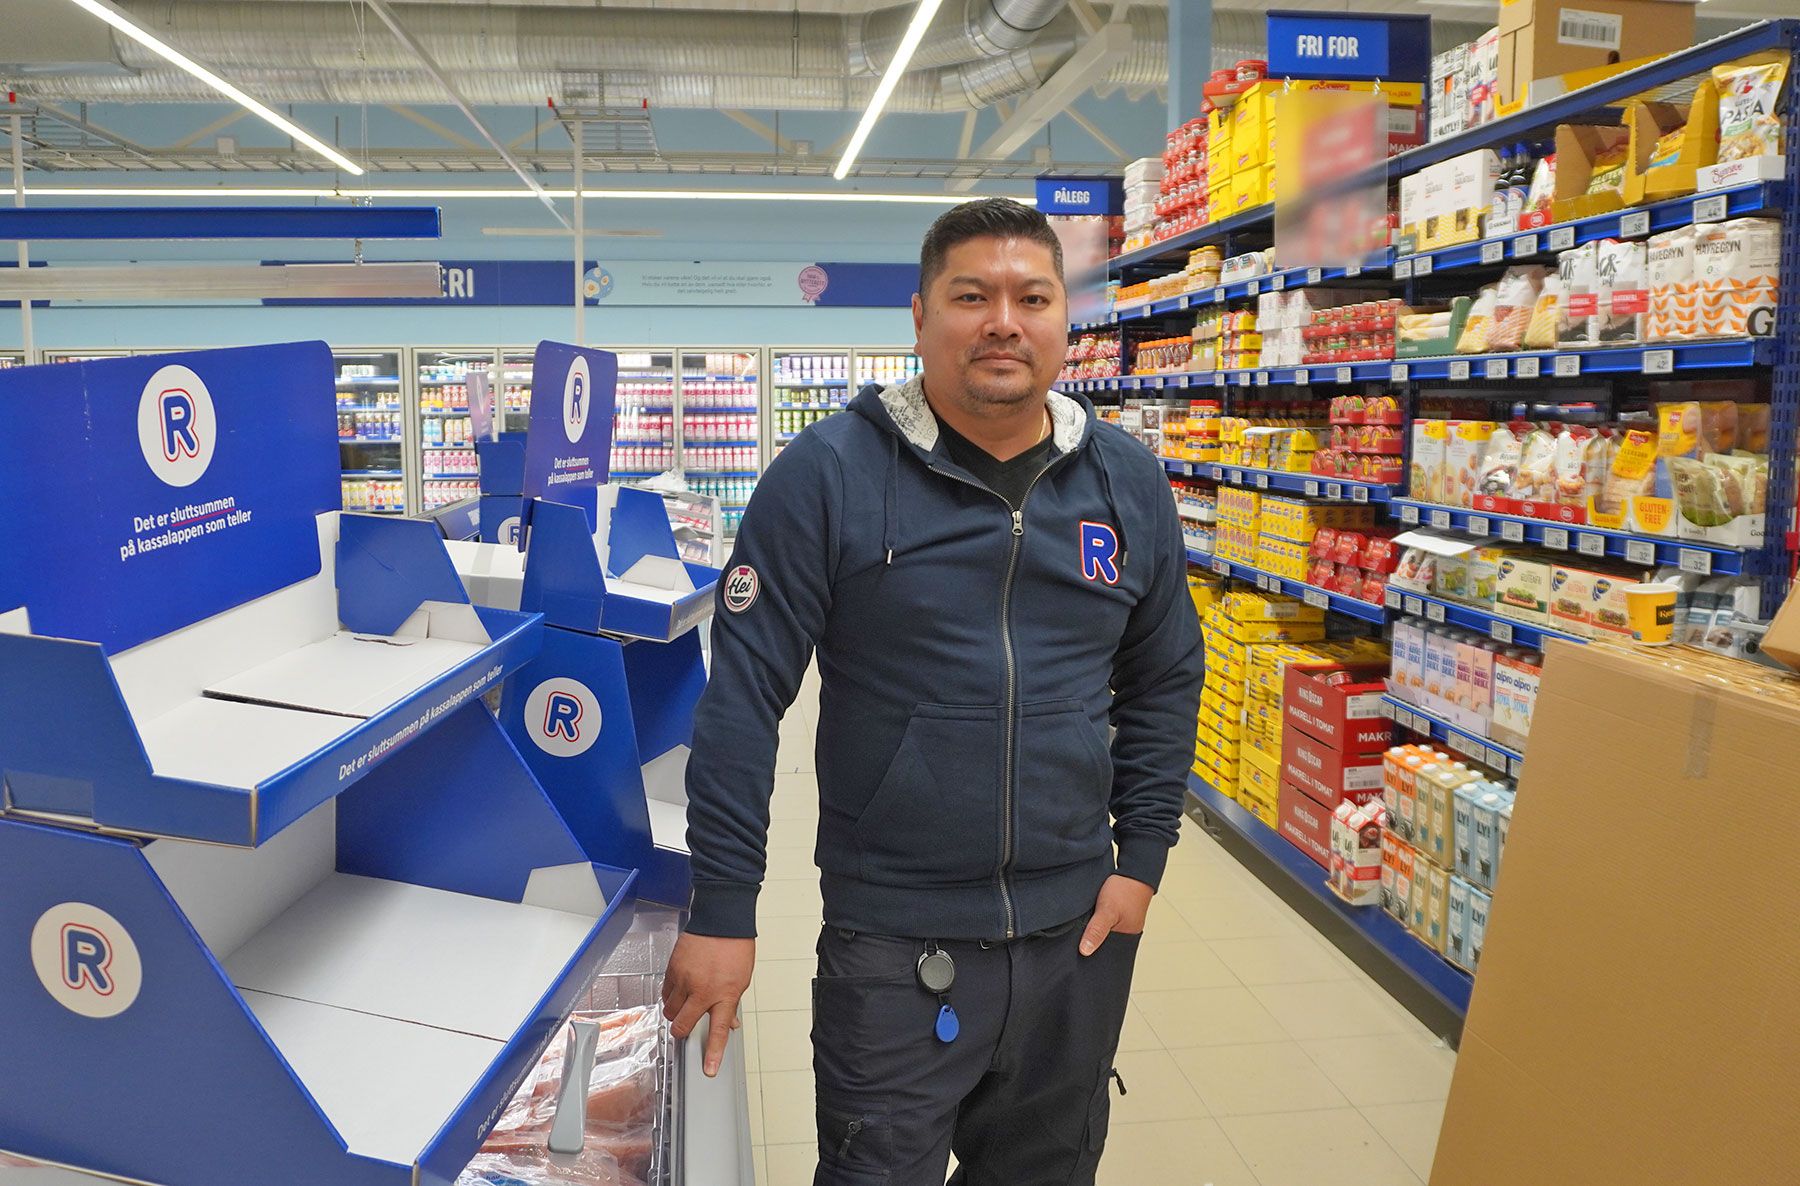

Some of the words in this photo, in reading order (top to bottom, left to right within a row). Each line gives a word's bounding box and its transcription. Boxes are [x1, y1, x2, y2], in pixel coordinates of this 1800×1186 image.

[1297, 34, 1323, 57] FRI
[1328, 35, 1359, 58] FOR
[1054, 186, 1090, 204] PÅLEGG
[1747, 306, 1776, 336] G
[570, 372, 584, 424] R
[158, 388, 200, 463] R
[133, 516, 156, 533] Det
[157, 513, 169, 526] er
[170, 496, 235, 524] sluttsummen
[1640, 502, 1670, 516] GLUTEN-
[1644, 512, 1662, 525] FREE
[120, 539, 137, 561] på
[137, 525, 204, 554] kassalappen
[205, 519, 226, 534] som
[227, 510, 252, 527] teller
[1080, 520, 1120, 585] R
[728, 576, 752, 595] Hei
[1496, 670, 1513, 685] alpro
[1514, 678, 1531, 692] alpro
[338, 762, 356, 781] Det
[356, 754, 368, 768] er
[367, 719, 419, 761] sluttsummen
[419, 709, 430, 729] på
[430, 684, 473, 720] kassalappen
[472, 676, 486, 692] som
[486, 664, 503, 682] teller
[543, 690, 583, 742] R
[1316, 717, 1335, 735] TOMAT
[61, 922, 115, 996] R
